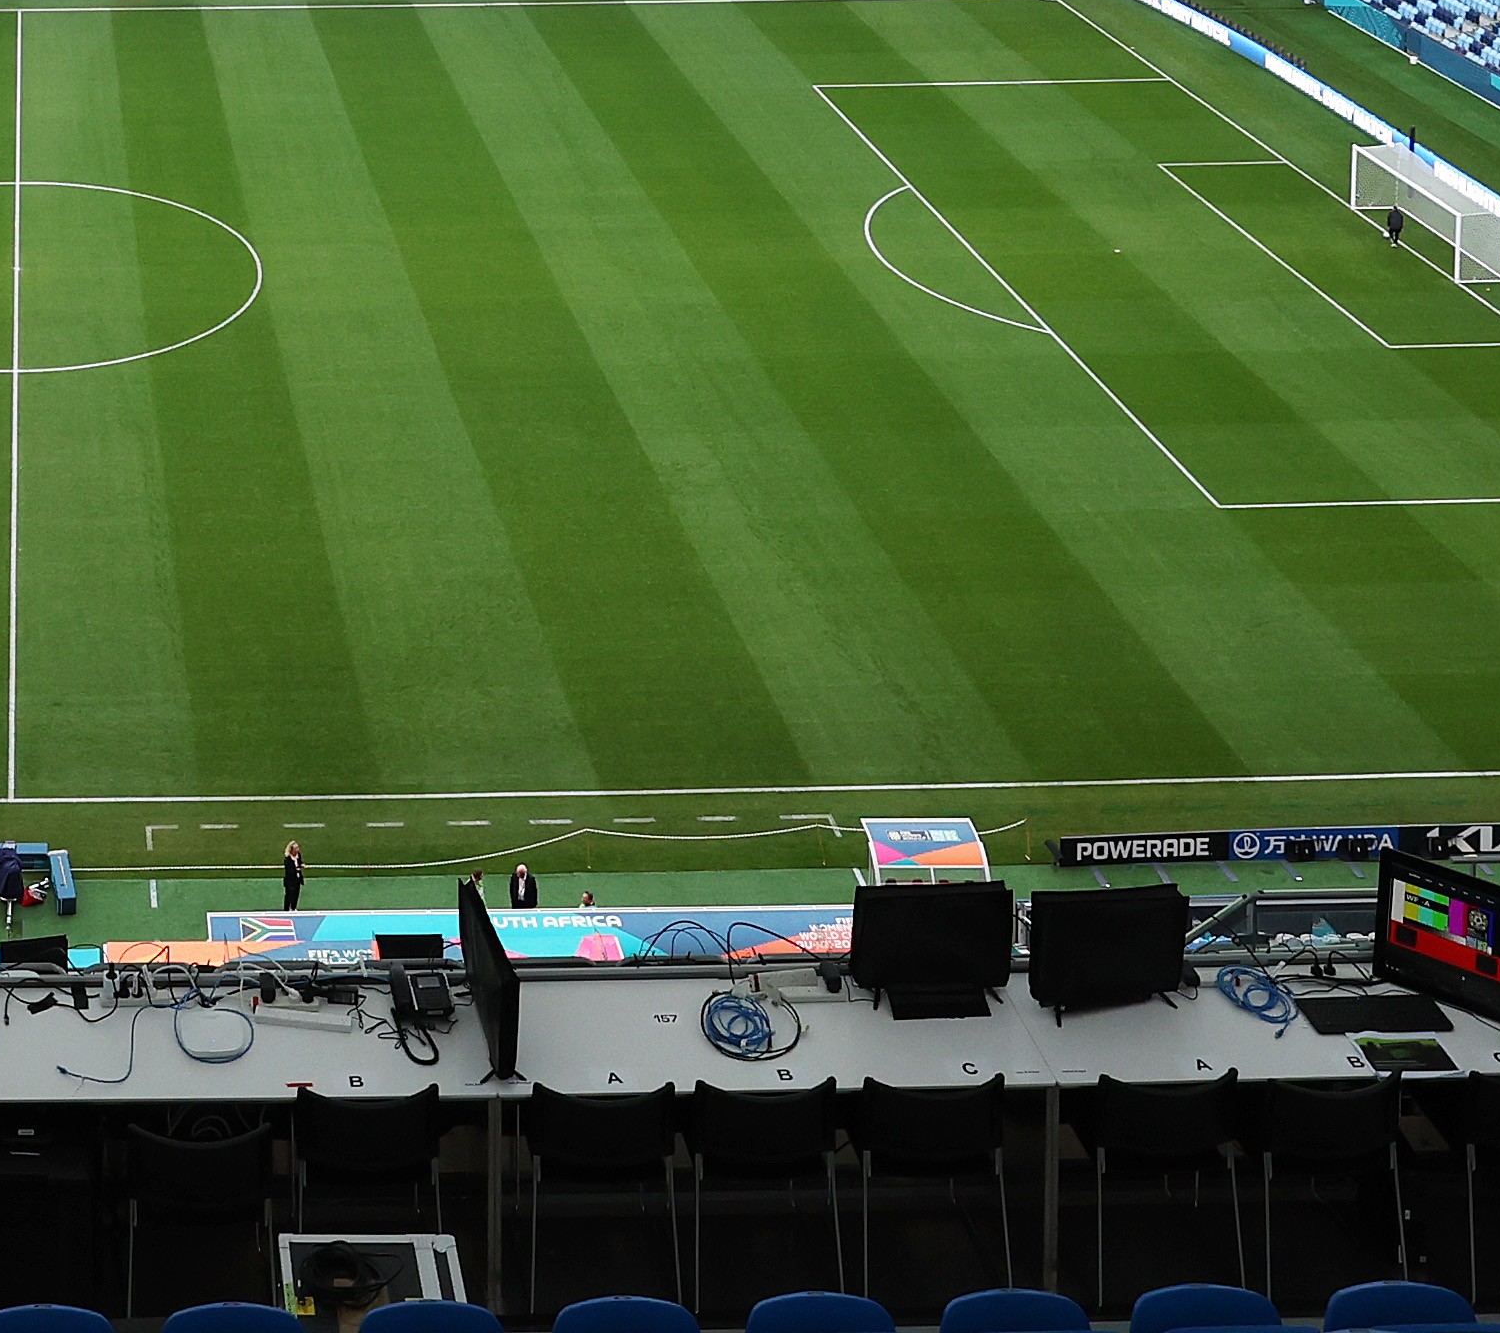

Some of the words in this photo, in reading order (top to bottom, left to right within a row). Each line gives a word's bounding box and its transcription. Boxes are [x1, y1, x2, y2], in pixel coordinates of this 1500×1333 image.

[1076, 837, 1210, 861] POWERADE
[543, 915, 622, 928] AFRICA
[809, 924, 853, 932] WOMEN
[653, 1014, 678, 1024] 157
[962, 1062, 979, 1075] C
[1196, 1059, 1213, 1071] A
[1346, 1055, 1365, 1069] B
[606, 1072, 624, 1084] A
[776, 1068, 794, 1081] B
[348, 1075, 364, 1088] B
